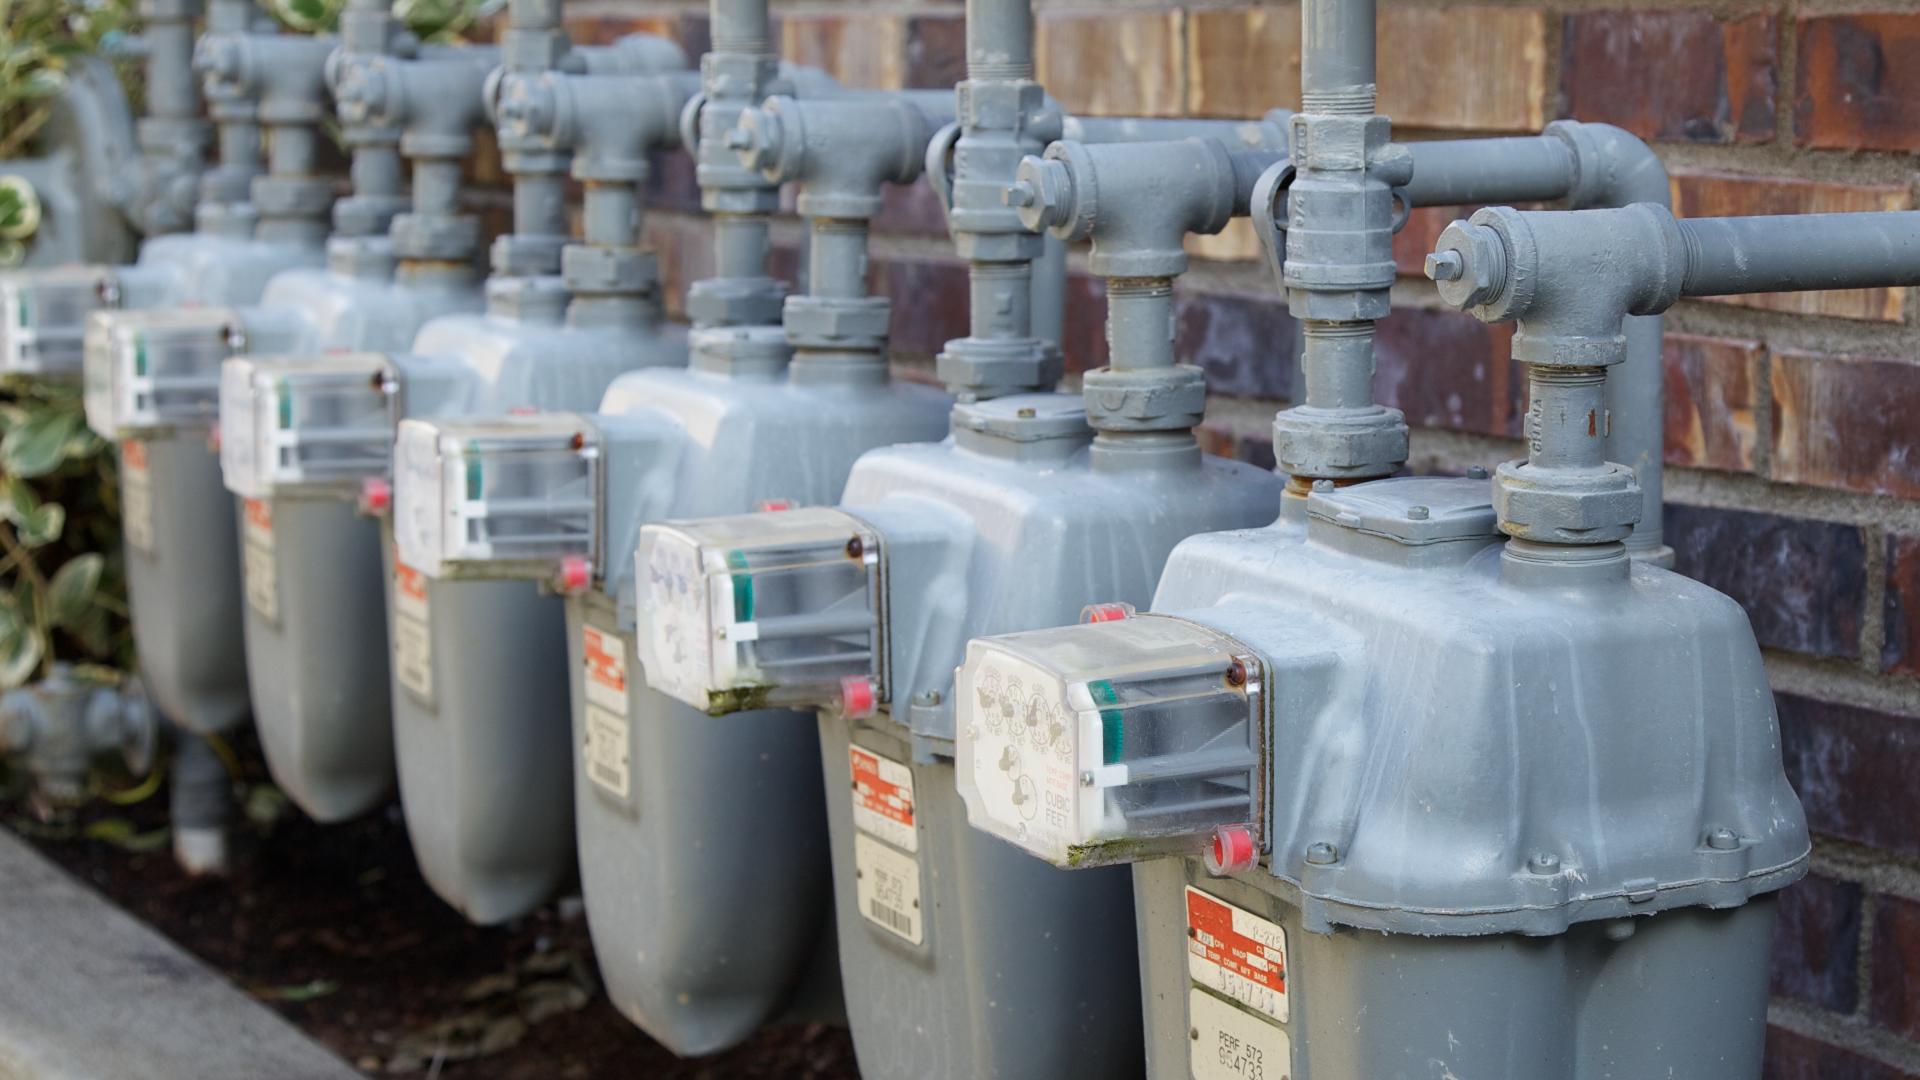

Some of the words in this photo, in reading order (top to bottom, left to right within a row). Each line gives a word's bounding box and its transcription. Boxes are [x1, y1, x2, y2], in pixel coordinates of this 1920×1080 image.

[1045, 790, 1070, 813] CUBIC
[1045, 808, 1068, 830] FEET
[1219, 1031, 1240, 1051] PERF
[1246, 1044, 1263, 1064] 572
